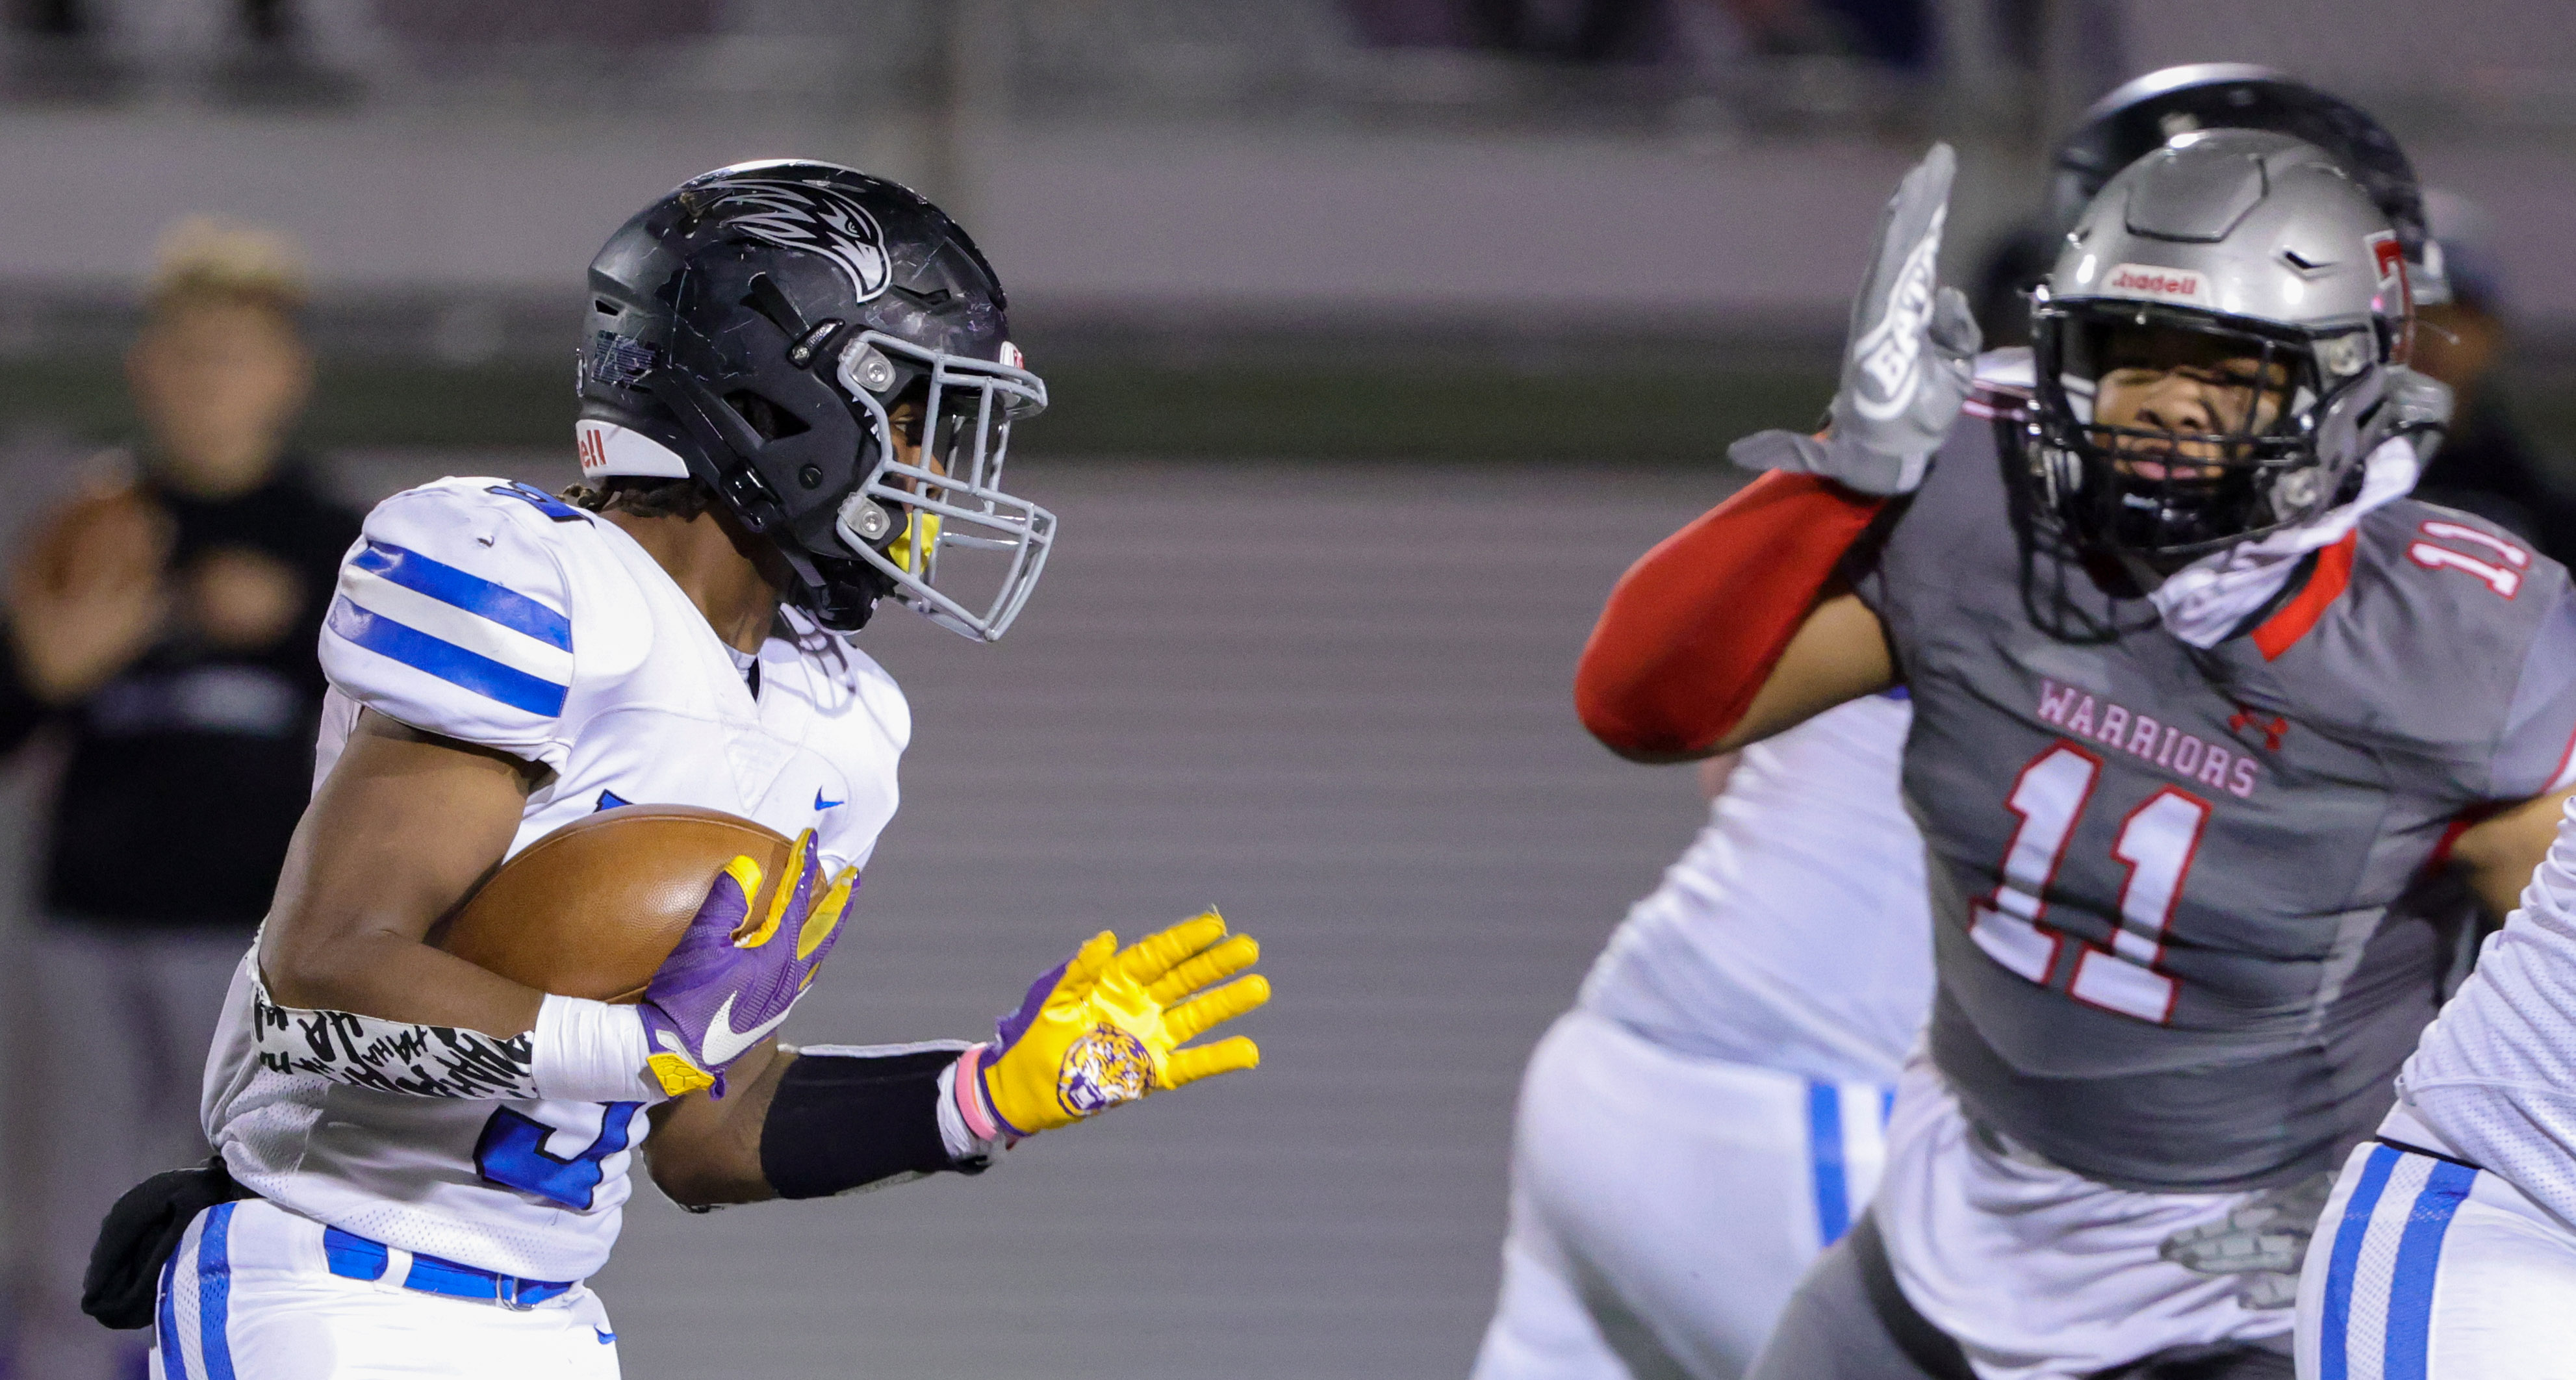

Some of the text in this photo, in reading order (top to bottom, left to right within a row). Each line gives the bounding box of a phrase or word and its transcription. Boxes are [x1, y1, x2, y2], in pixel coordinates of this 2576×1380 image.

[2406, 519, 2532, 602] 11
[2036, 680, 2260, 799] WARRIORS
[1969, 739, 2212, 1027] 11
